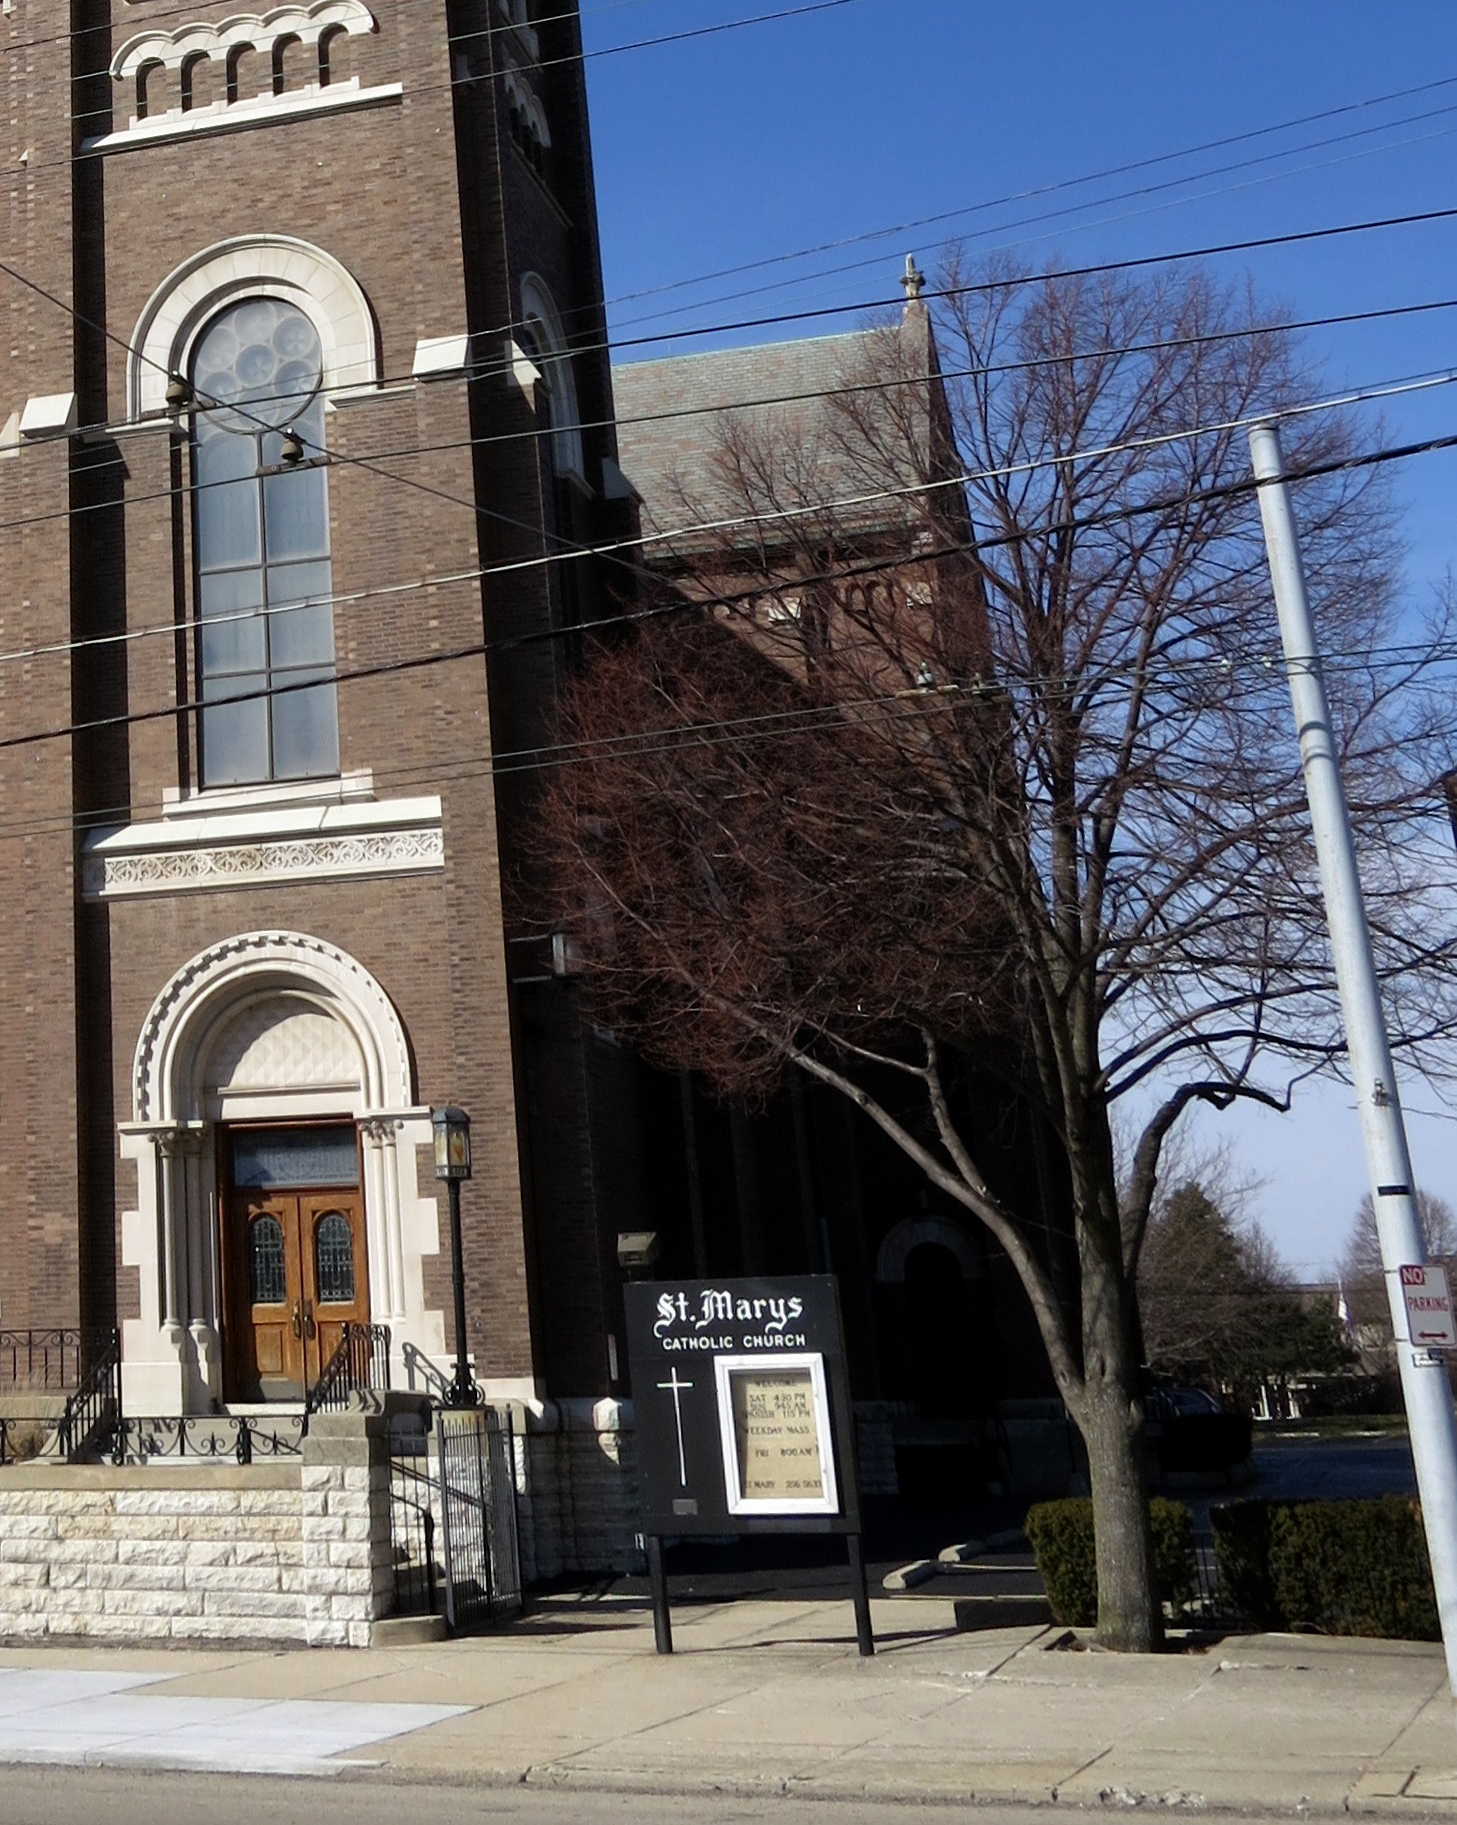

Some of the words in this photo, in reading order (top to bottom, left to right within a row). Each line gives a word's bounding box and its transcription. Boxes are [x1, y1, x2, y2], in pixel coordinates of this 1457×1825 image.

[1402, 1267, 1424, 1284] NO
[695, 1289, 803, 1334] Marys
[1407, 1296, 1449, 1312] PARKING
[662, 1335, 733, 1350] CATHOLIC
[743, 1334, 806, 1348] CHURCH
[749, 1394, 765, 1402] SAT
[786, 1426, 810, 1434] MASS
